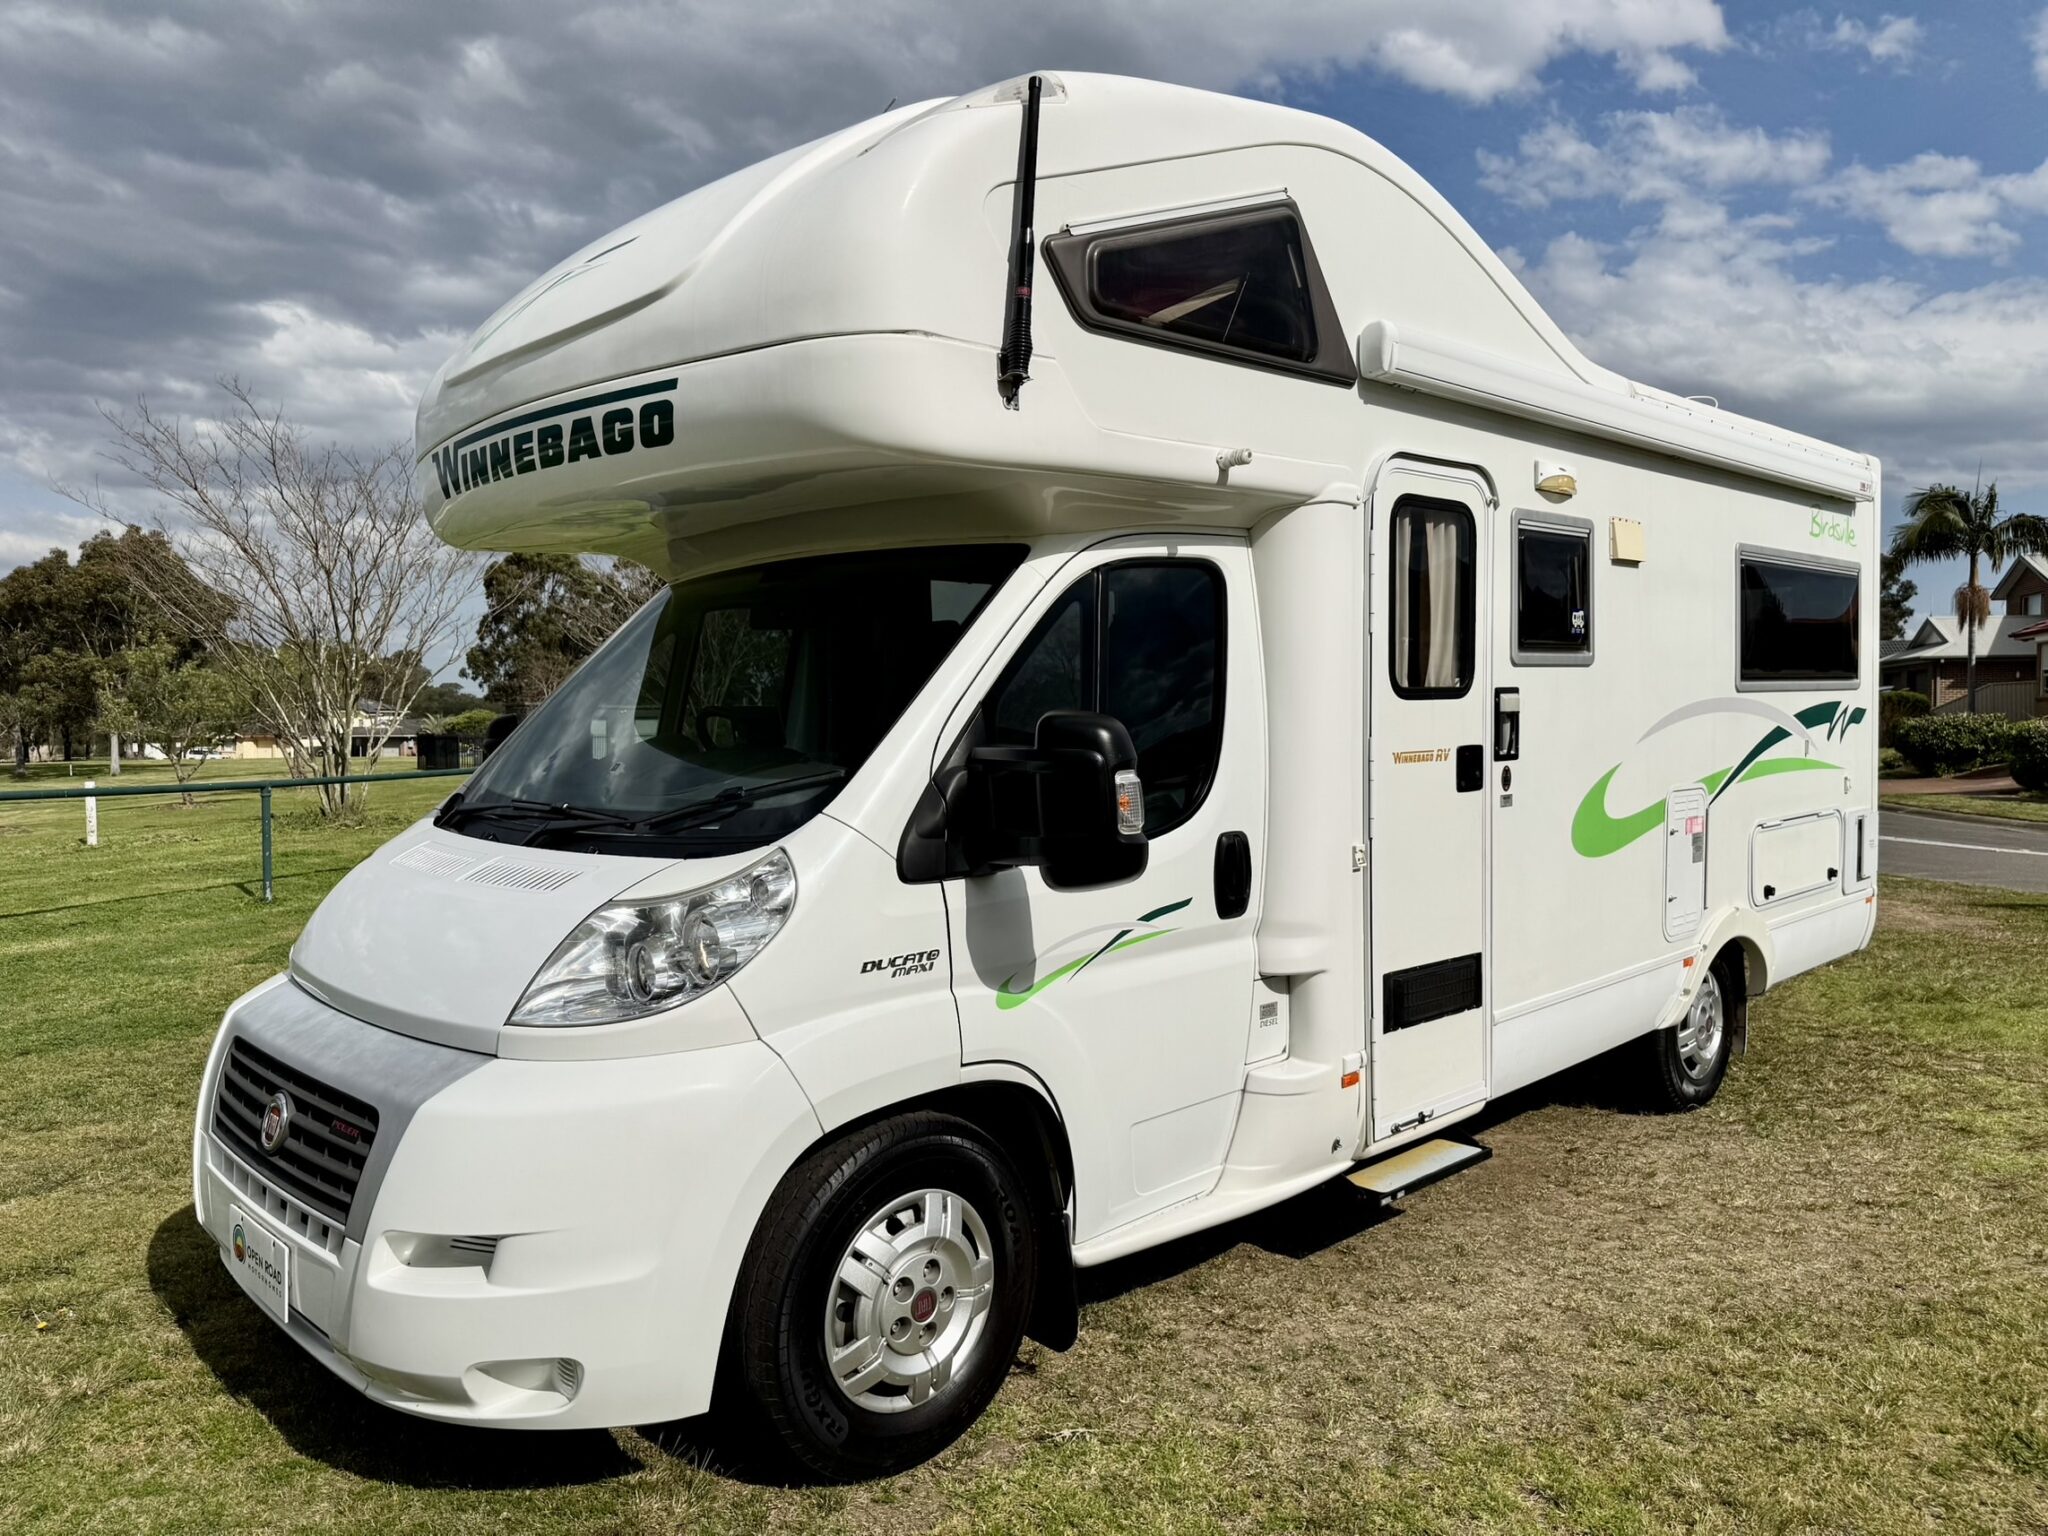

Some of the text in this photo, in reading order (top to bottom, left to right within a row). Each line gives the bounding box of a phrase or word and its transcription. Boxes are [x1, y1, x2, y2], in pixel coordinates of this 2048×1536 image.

[432, 379, 678, 500] WINNEBAGO
[1392, 748, 1451, 764] WINNEBAGO RV
[860, 948, 940, 974] DUCATO
[891, 961, 935, 978] MAXI
[246, 1245, 282, 1285] OPEN ROAD
[247, 1263, 282, 1298] MOTORHOMES
